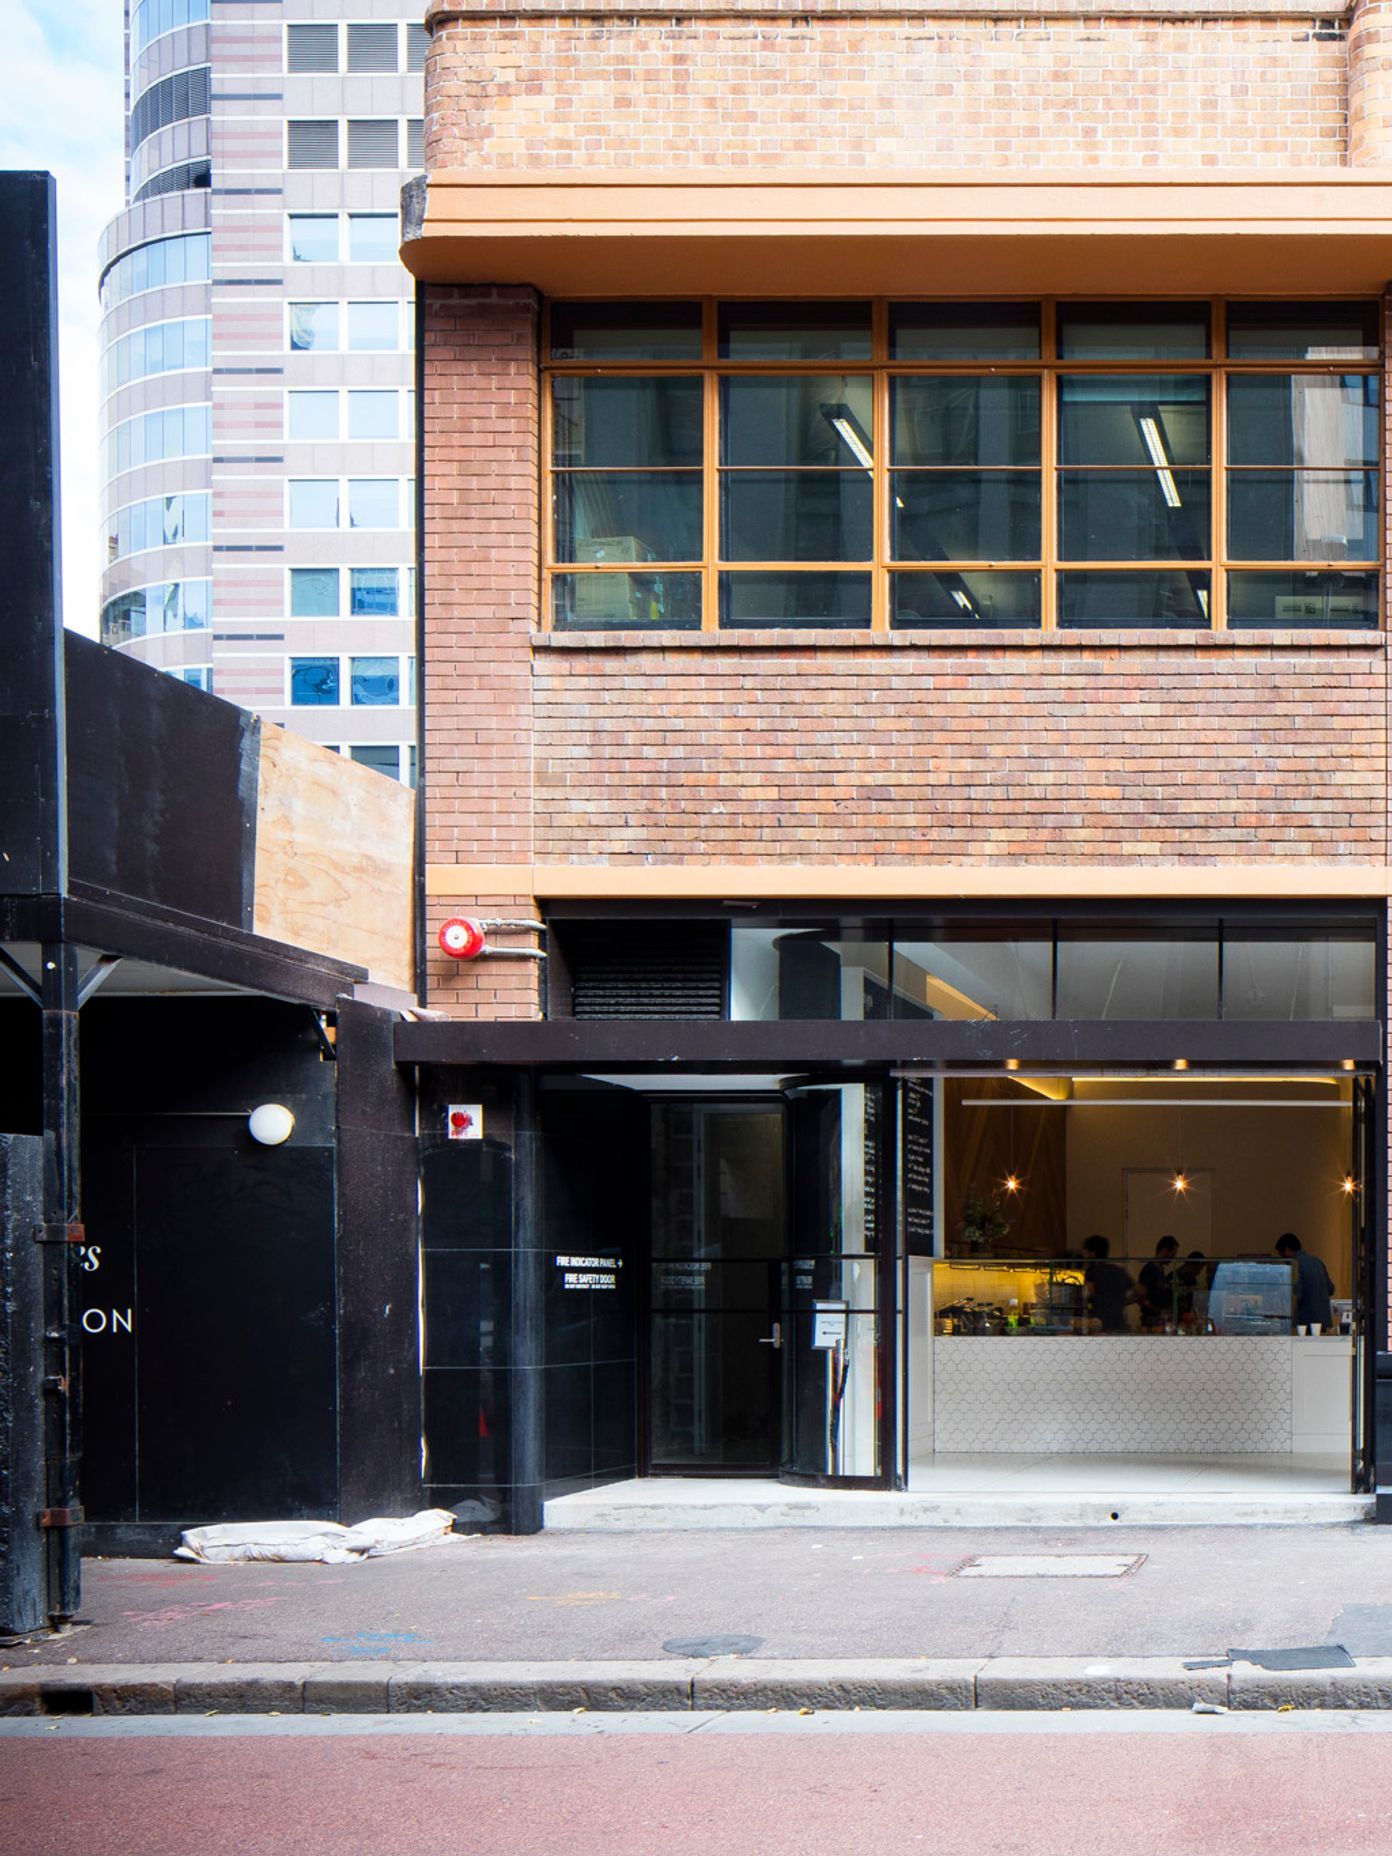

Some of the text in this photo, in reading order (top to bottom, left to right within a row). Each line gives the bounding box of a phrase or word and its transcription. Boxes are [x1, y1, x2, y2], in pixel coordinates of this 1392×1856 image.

[556, 1255, 570, 1267] FIRE
[564, 1272, 616, 1284] FIRE SAFETY DOOR
